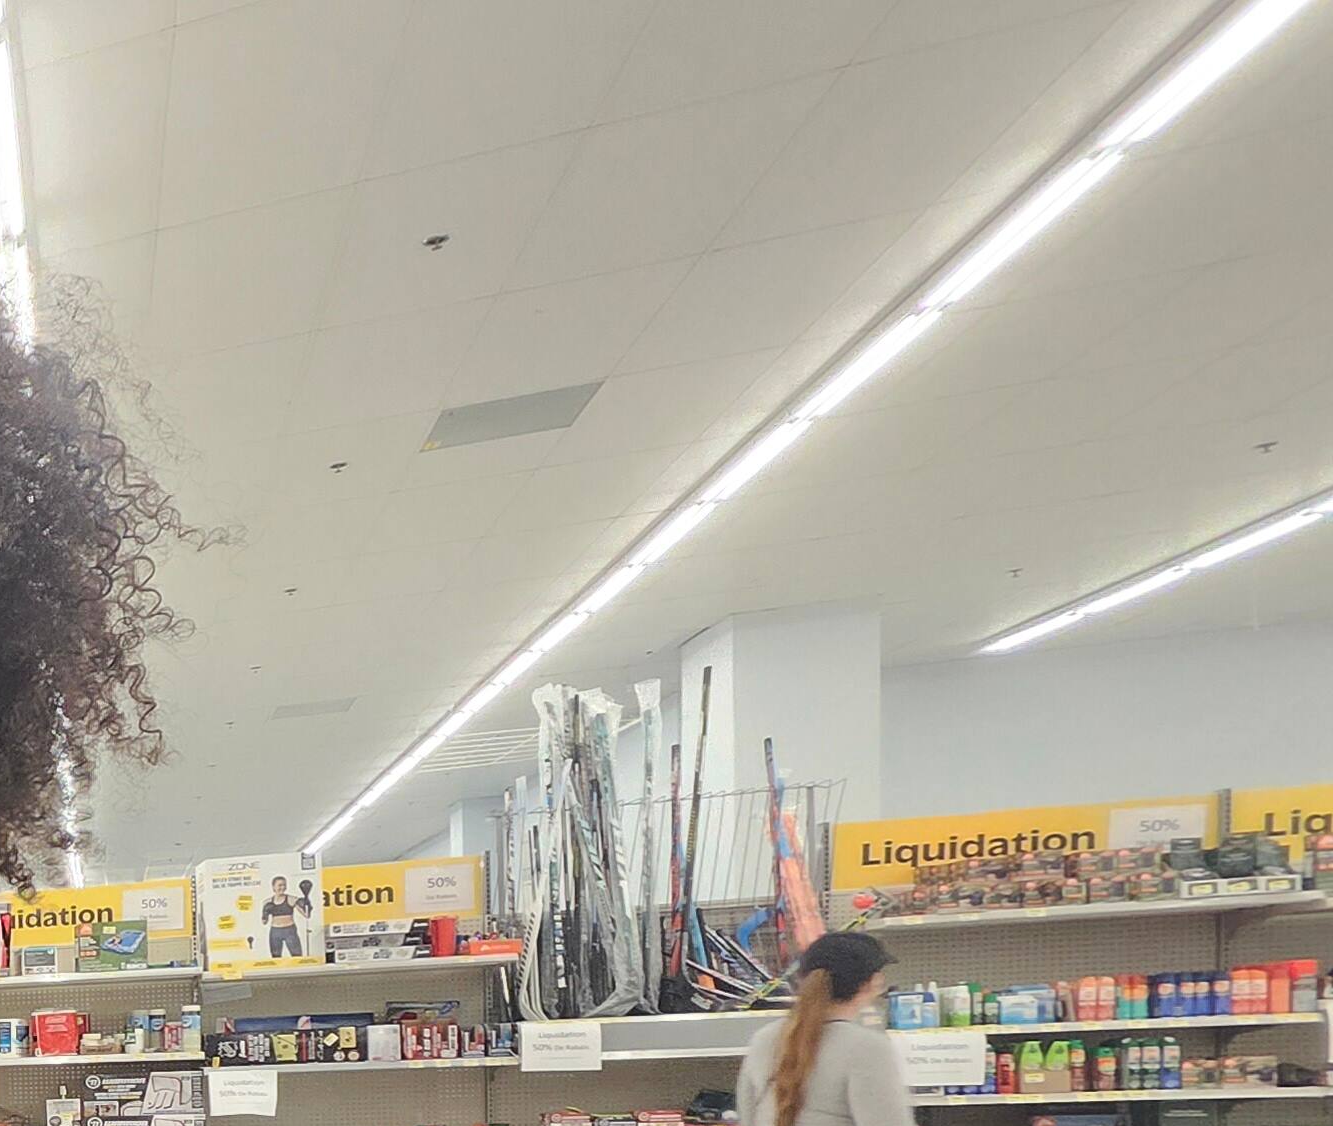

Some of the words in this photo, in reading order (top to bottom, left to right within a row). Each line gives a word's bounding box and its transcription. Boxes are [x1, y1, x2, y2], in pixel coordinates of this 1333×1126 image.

[1139, 818, 1181, 833] 50%
[861, 829, 1096, 868] Liquidation
[426, 877, 457, 889] 50%
[141, 898, 168, 909] 50%
